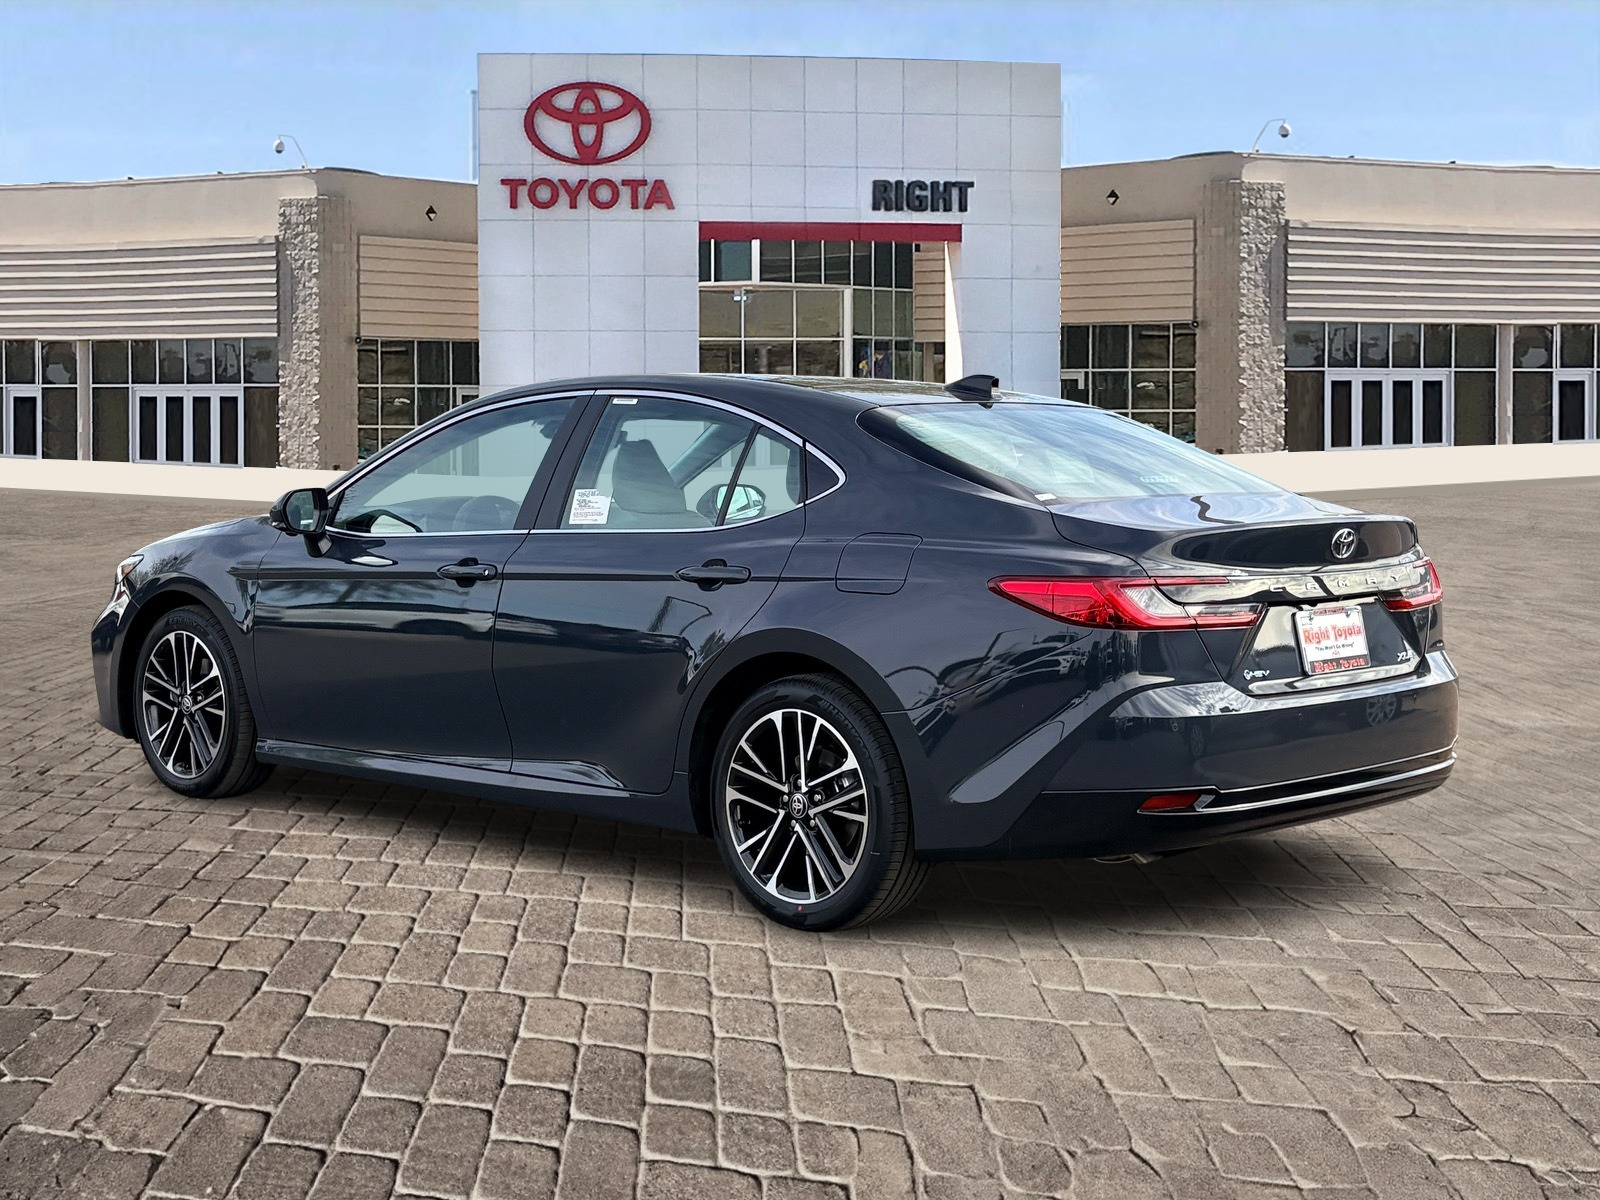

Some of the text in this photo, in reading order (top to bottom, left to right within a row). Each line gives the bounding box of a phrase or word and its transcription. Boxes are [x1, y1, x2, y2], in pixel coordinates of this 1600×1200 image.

[500, 178, 675, 210] TOYOTA
[871, 179, 975, 213] RIGHT
[1269, 575, 1401, 592] CAMRY
[1303, 624, 1362, 645] Right Toyota
[1313, 658, 1366, 673] Right Toyota
